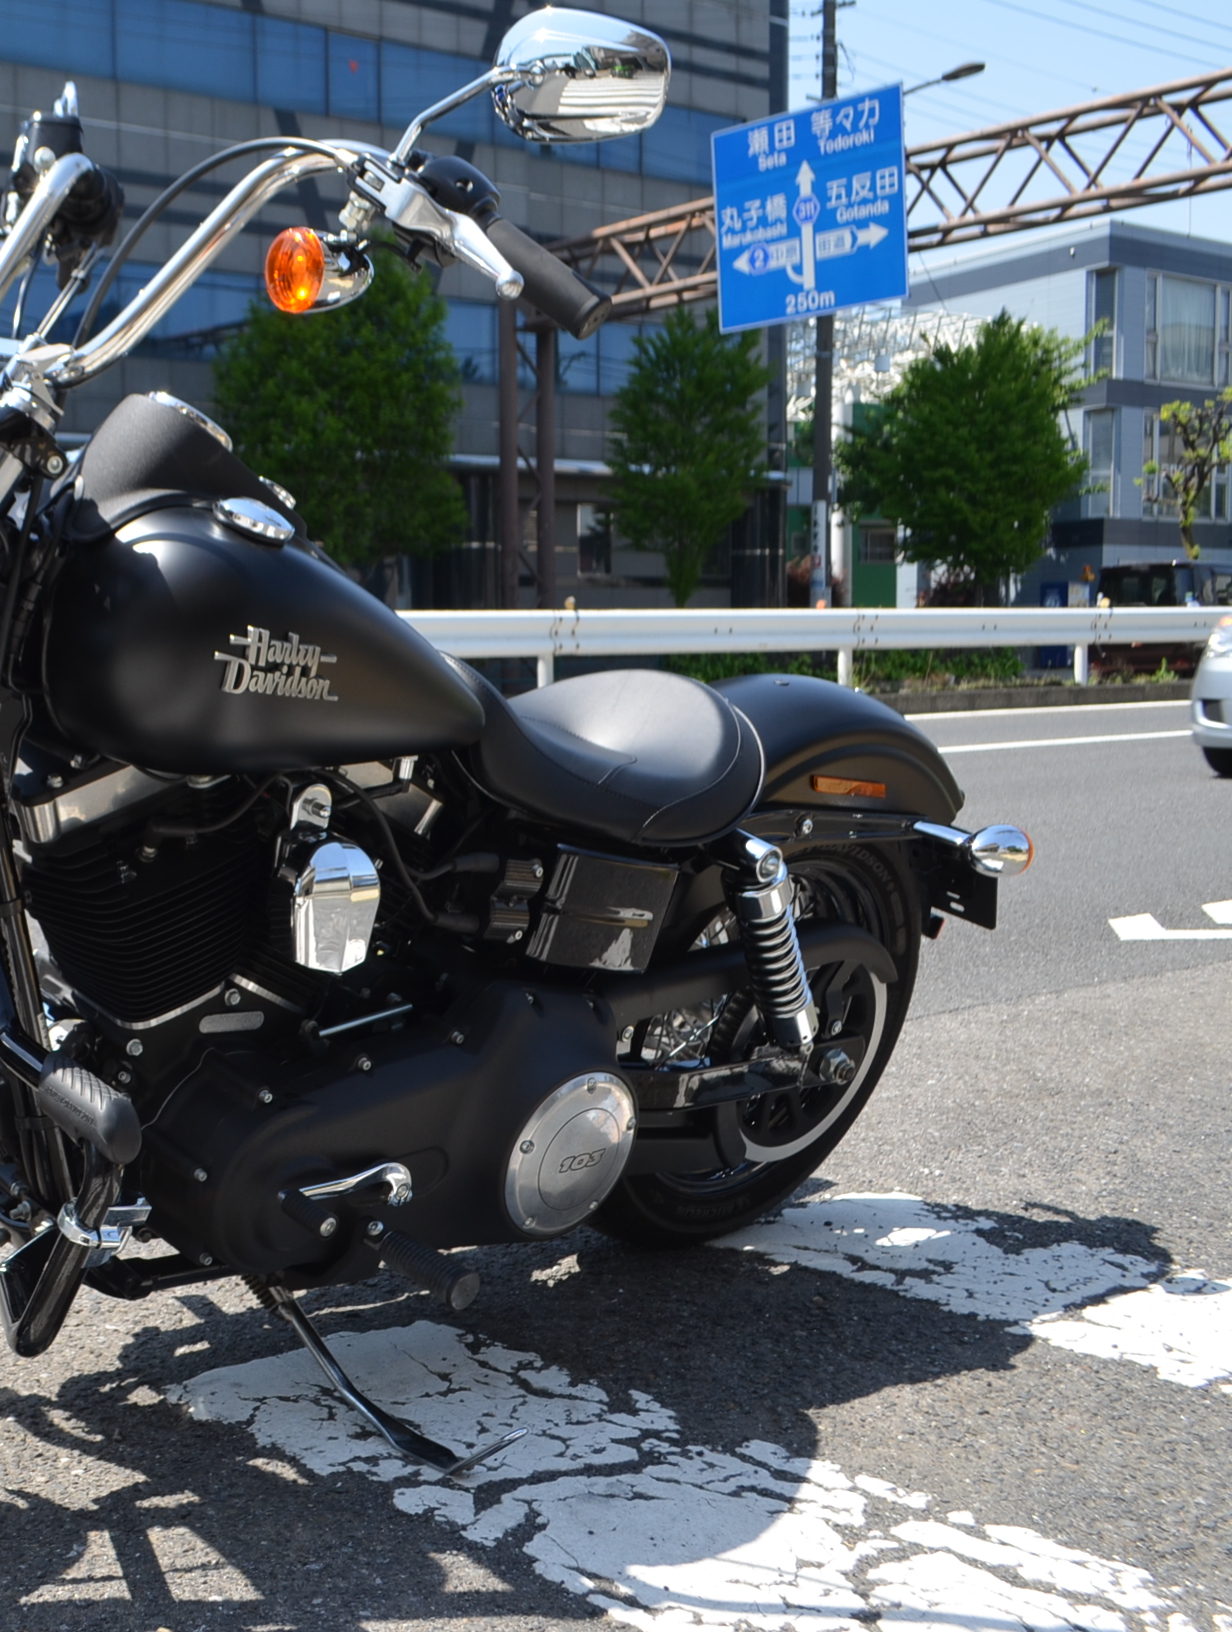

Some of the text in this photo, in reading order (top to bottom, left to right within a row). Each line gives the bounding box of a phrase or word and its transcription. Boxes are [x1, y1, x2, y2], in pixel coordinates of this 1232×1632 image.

[748, 97, 880, 158] 瀬田 等々力
[758, 127, 875, 172] Seta Todoroki
[826, 165, 898, 210] 五反田
[721, 192, 787, 234] 丸子橋
[796, 202, 815, 220] 311
[836, 197, 890, 224] Gotanda
[753, 248, 766, 269] 2
[785, 290, 836, 316] 250m
[214, 650, 339, 702] Davidson
[558, 1147, 607, 1174] 103
